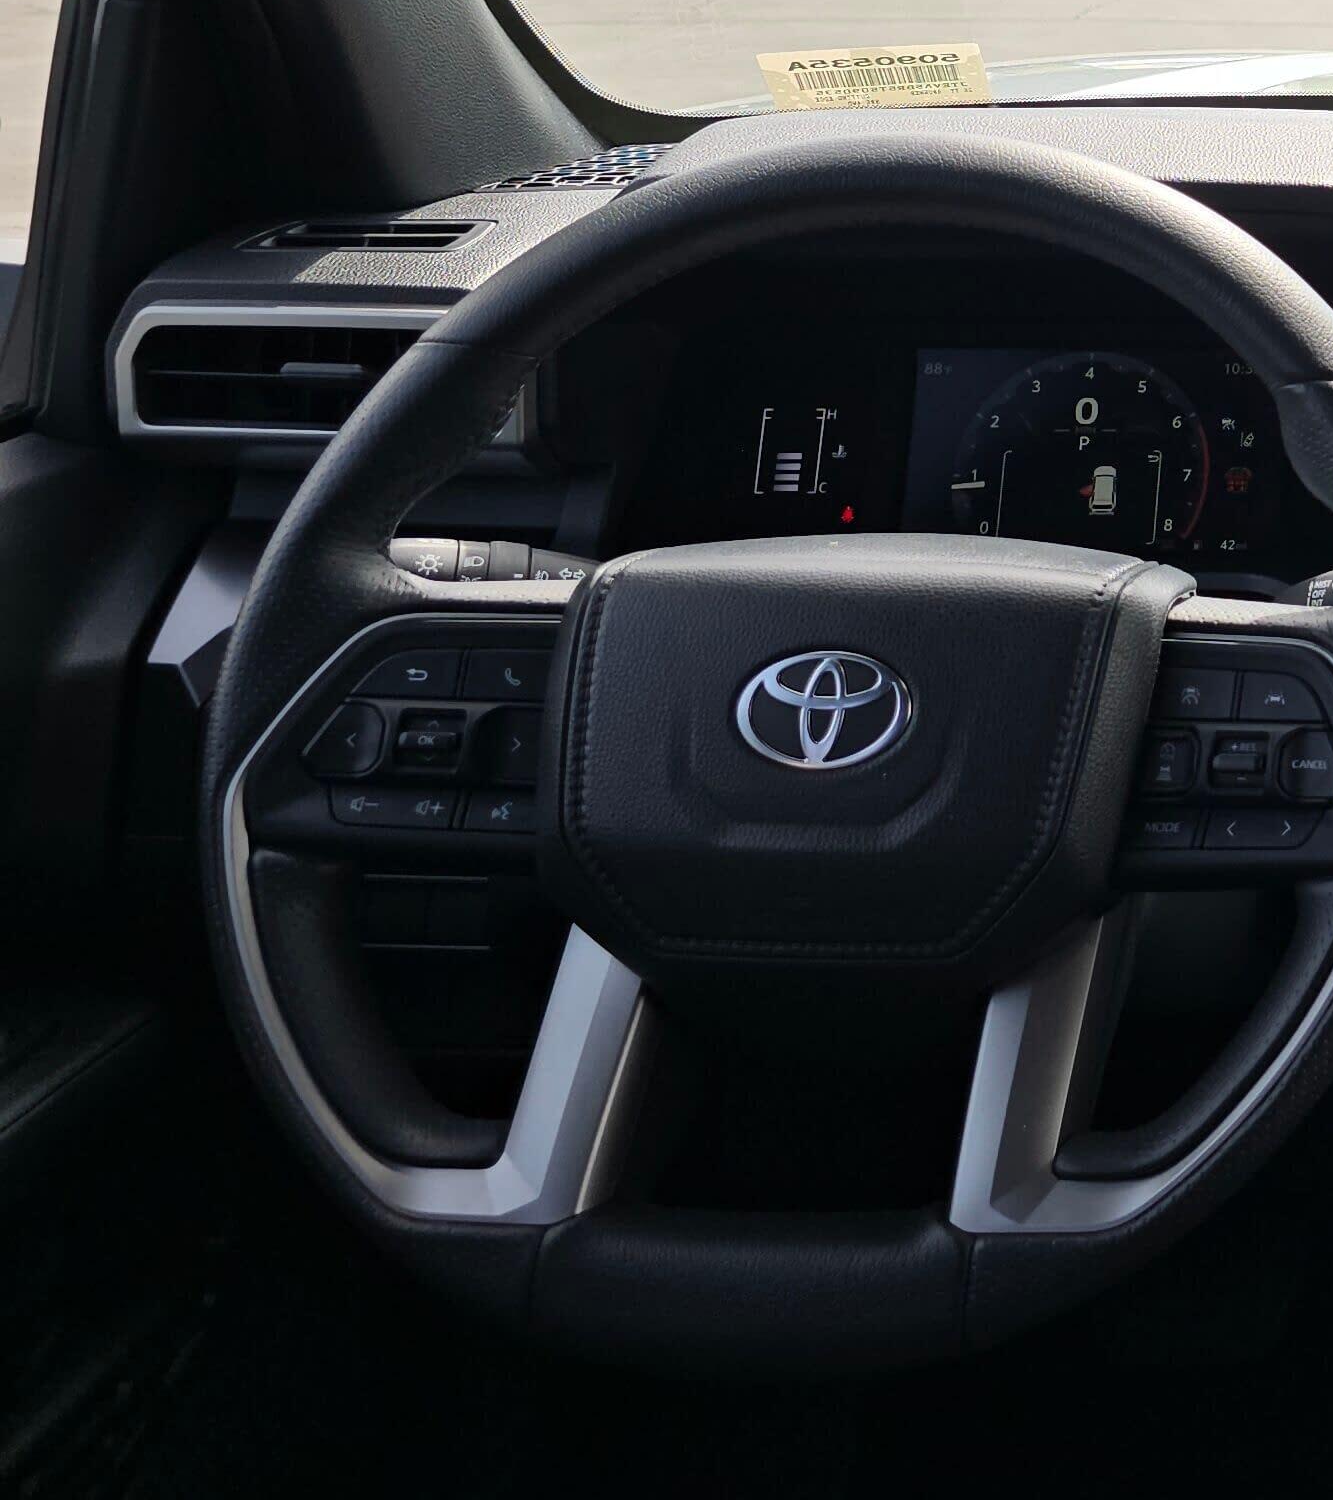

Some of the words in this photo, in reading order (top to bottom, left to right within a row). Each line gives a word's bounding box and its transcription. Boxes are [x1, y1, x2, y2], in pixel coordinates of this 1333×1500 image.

[1085, 367, 1095, 380] 4
[1032, 380, 1041, 393] 3
[1137, 380, 1147, 393] 5
[827, 408, 837, 420] H
[1075, 397, 1099, 425] 0
[990, 415, 1000, 428] 2
[1172, 416, 1182, 429] 6
[1079, 436, 1090, 451] P
[971, 469, 978, 481] 1
[1182, 469, 1193, 482] 7
[819, 482, 828, 494] C
[979, 521, 989, 534] 0
[1164, 519, 1173, 531] 8
[417, 735, 436, 746] OK
[1291, 759, 1328, 770] CANCEL
